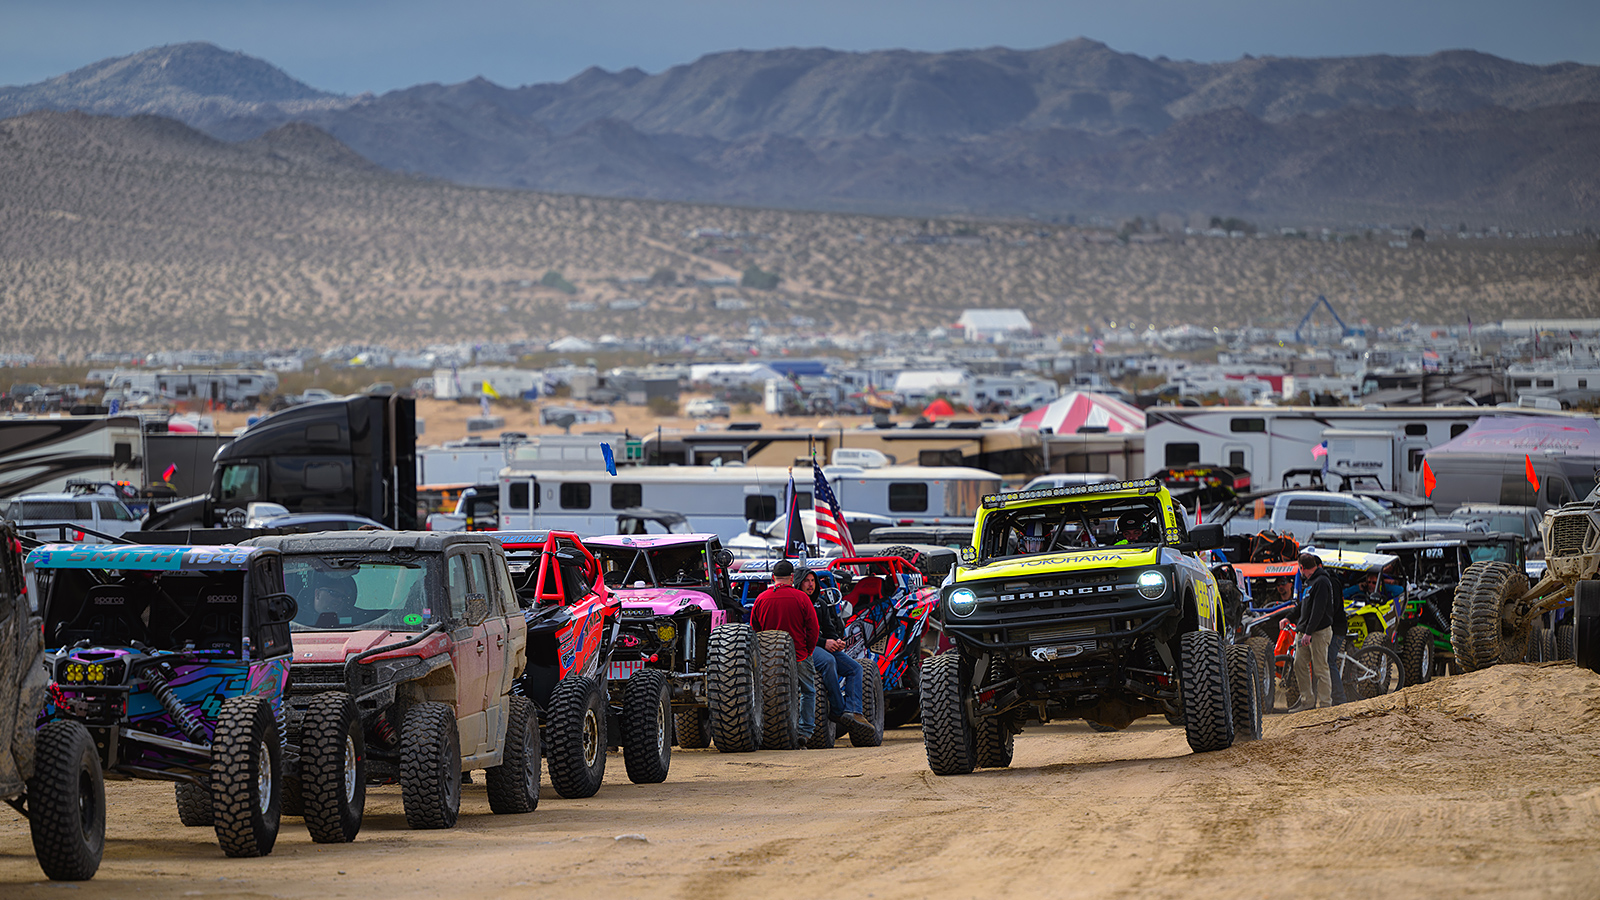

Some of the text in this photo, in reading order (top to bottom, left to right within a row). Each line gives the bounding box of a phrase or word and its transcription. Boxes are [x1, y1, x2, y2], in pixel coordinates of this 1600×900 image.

[66, 552, 176, 563] SMITH
[187, 553, 248, 564] 1948
[1019, 555, 1122, 567] YOKOHAMA
[207, 595, 237, 603] sparco
[1000, 585, 1113, 601] BRONCO
[94, 596, 124, 604] sparco
